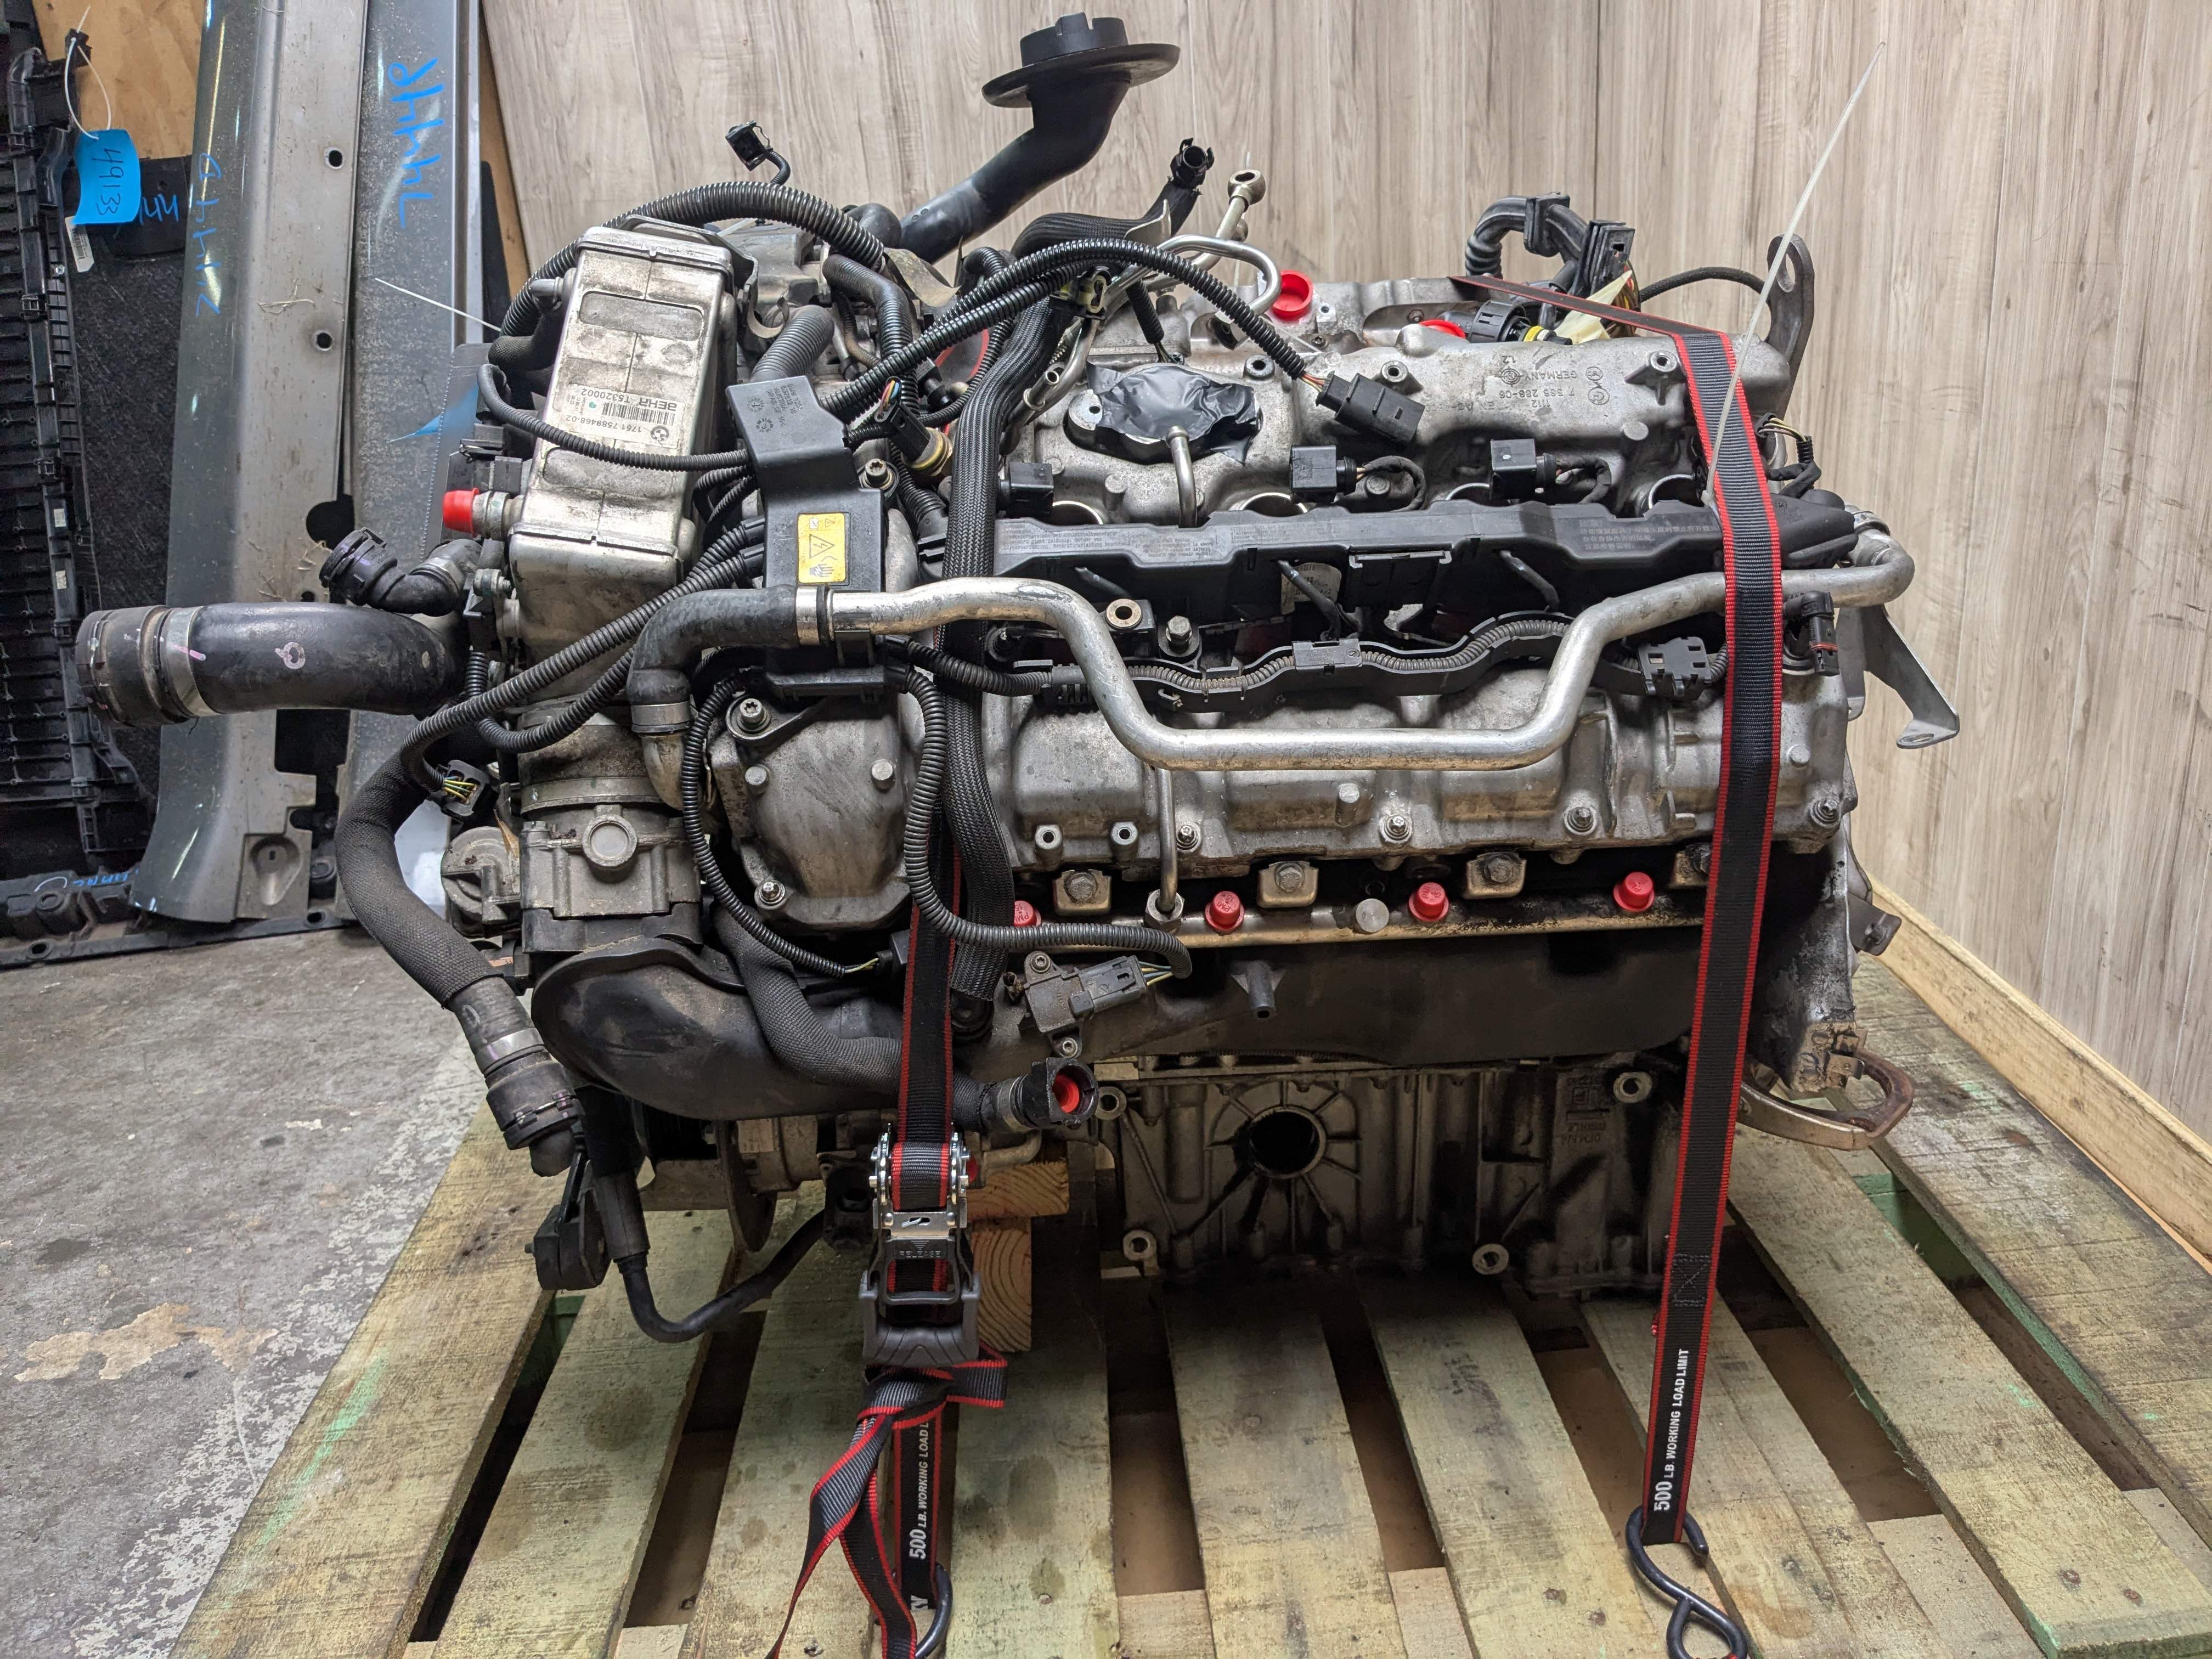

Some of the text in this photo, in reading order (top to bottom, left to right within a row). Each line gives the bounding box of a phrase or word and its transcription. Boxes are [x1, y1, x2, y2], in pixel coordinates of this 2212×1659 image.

[92, 148, 125, 215] 49133
[1525, 370, 1577, 381] GERMANY
[581, 387, 630, 403] T5320002
[638, 397, 678, 411] BEHR
[566, 415, 642, 433] 1751 7589468-02
[1422, 885, 1431, 900] PMI
[1216, 900, 1232, 912] PMI
[1015, 913, 1029, 923] PMI
[1677, 1348, 1689, 1376] LIMIT
[1672, 1378, 1686, 1407] LOAD
[919, 1430, 929, 1457] LOAD
[1666, 1410, 1681, 1459] WORKING
[918, 1461, 929, 1509] WORKING
[1654, 1481, 1673, 1511] 500
[918, 1511, 928, 1528] LB.
[909, 1528, 928, 1560] 500
